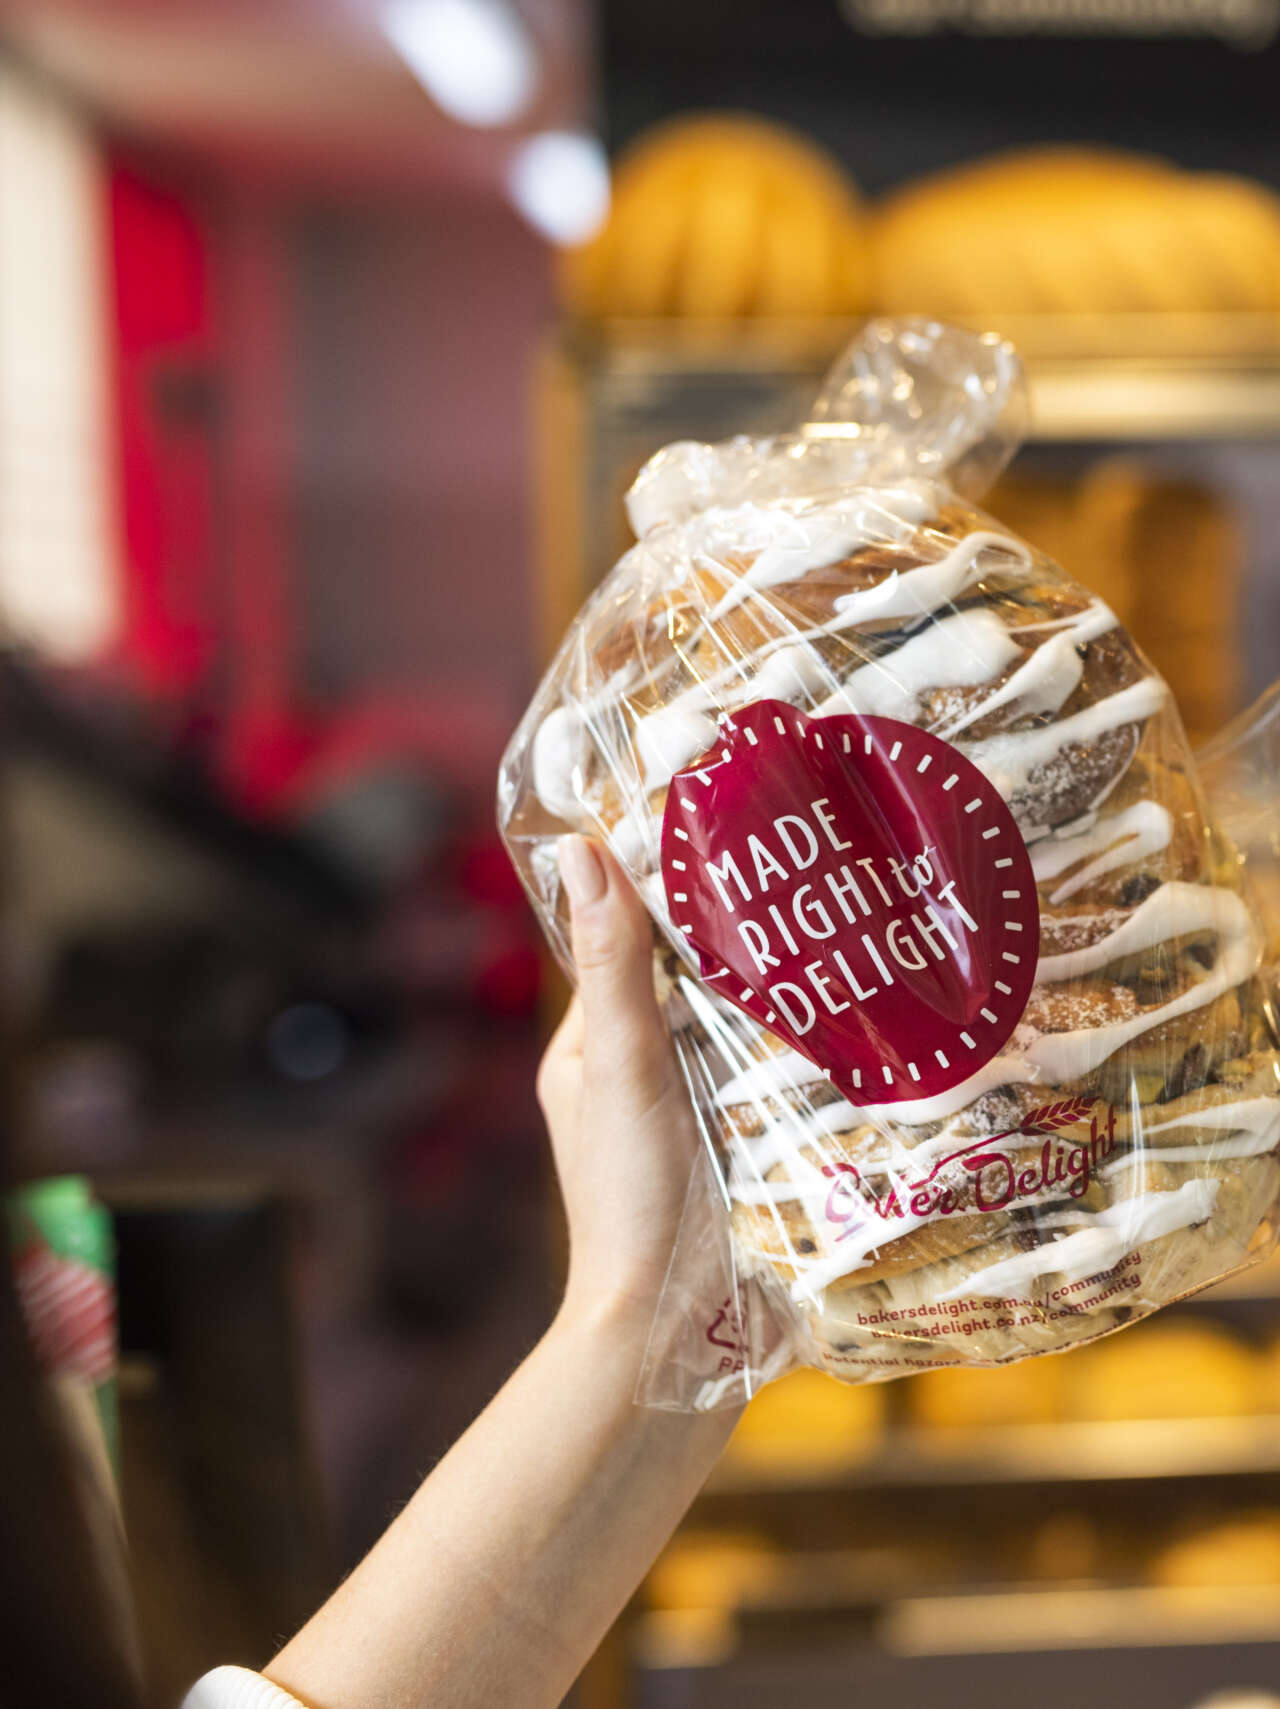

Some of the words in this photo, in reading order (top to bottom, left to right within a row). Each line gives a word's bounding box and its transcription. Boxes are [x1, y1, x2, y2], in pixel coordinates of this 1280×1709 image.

[704, 798, 853, 913] MADE
[737, 856, 893, 976] RIGHT
[886, 845, 937, 897] to
[768, 881, 979, 1037] DELIGHT
[961, 1103, 1117, 1213] Delight
